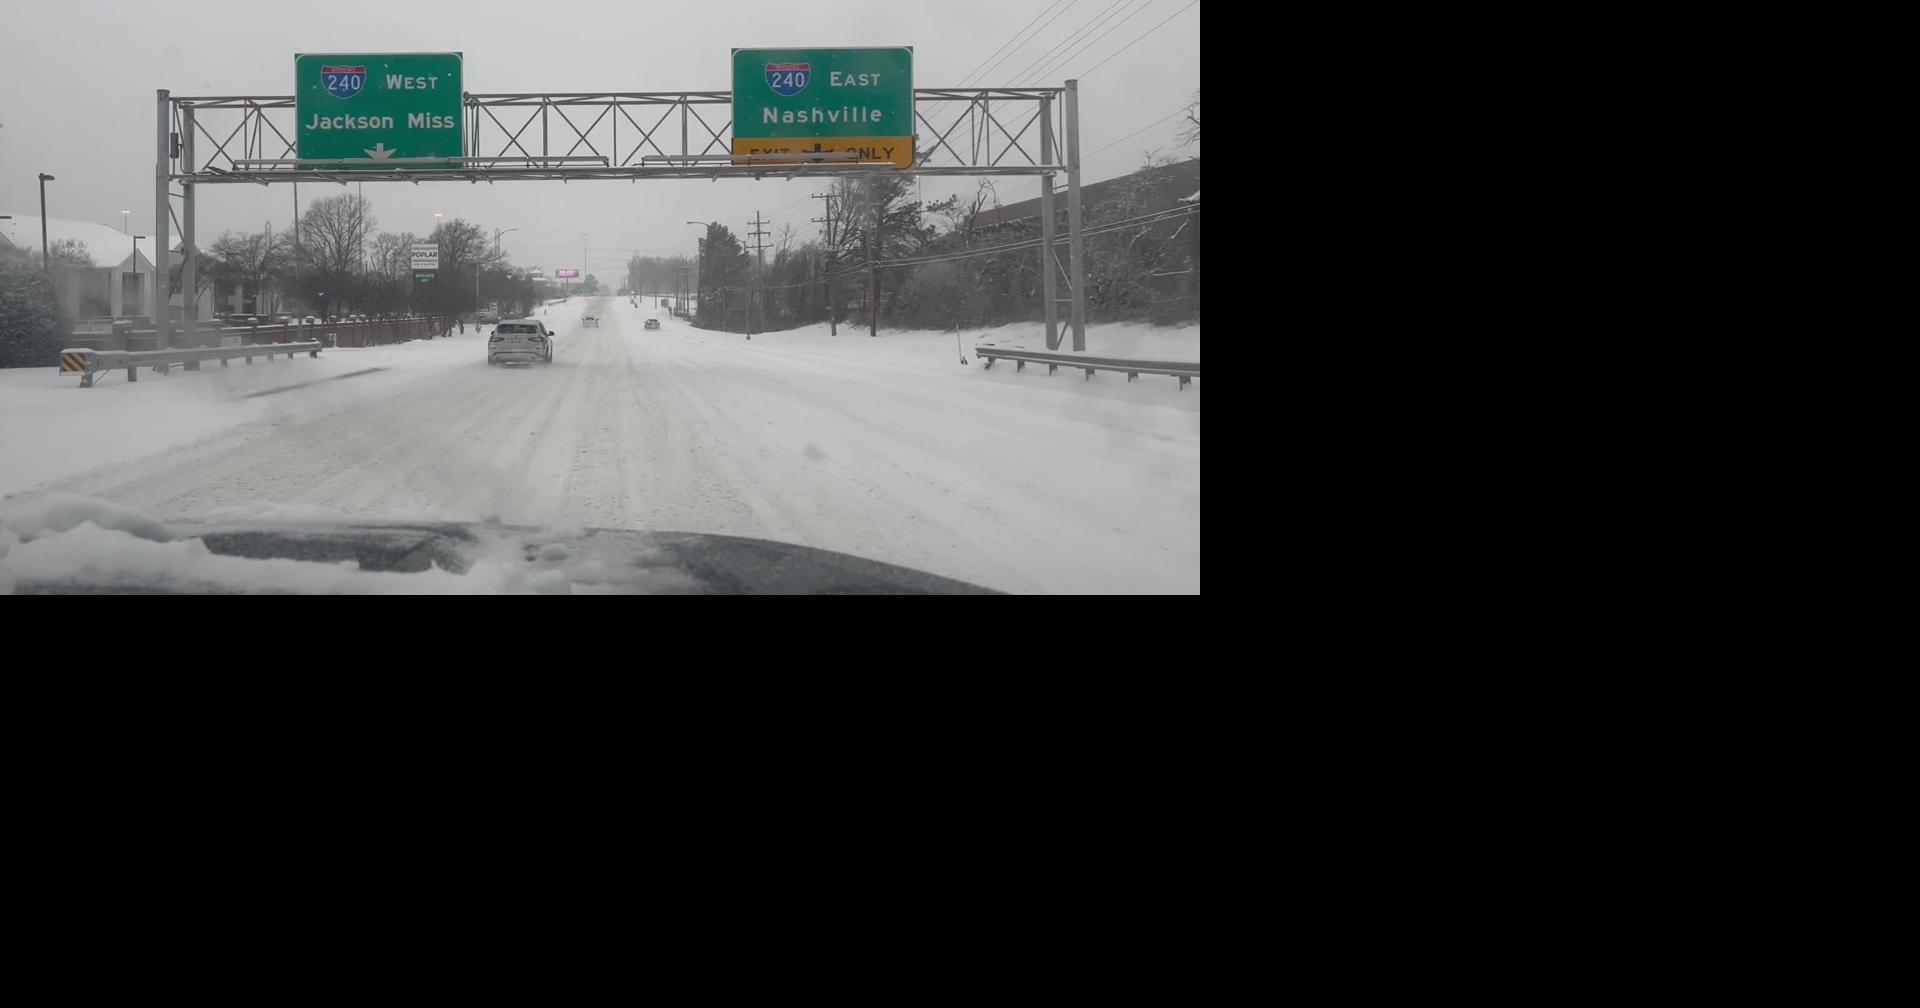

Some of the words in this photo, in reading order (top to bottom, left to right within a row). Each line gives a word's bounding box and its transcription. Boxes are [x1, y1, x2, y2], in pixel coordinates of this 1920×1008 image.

[327, 74, 361, 90] 240
[386, 74, 439, 90] WEST
[772, 72, 805, 88] 240
[830, 71, 881, 87] EAST
[305, 113, 394, 130] Jackson
[408, 112, 455, 129] Miss
[763, 106, 882, 123] Nashville
